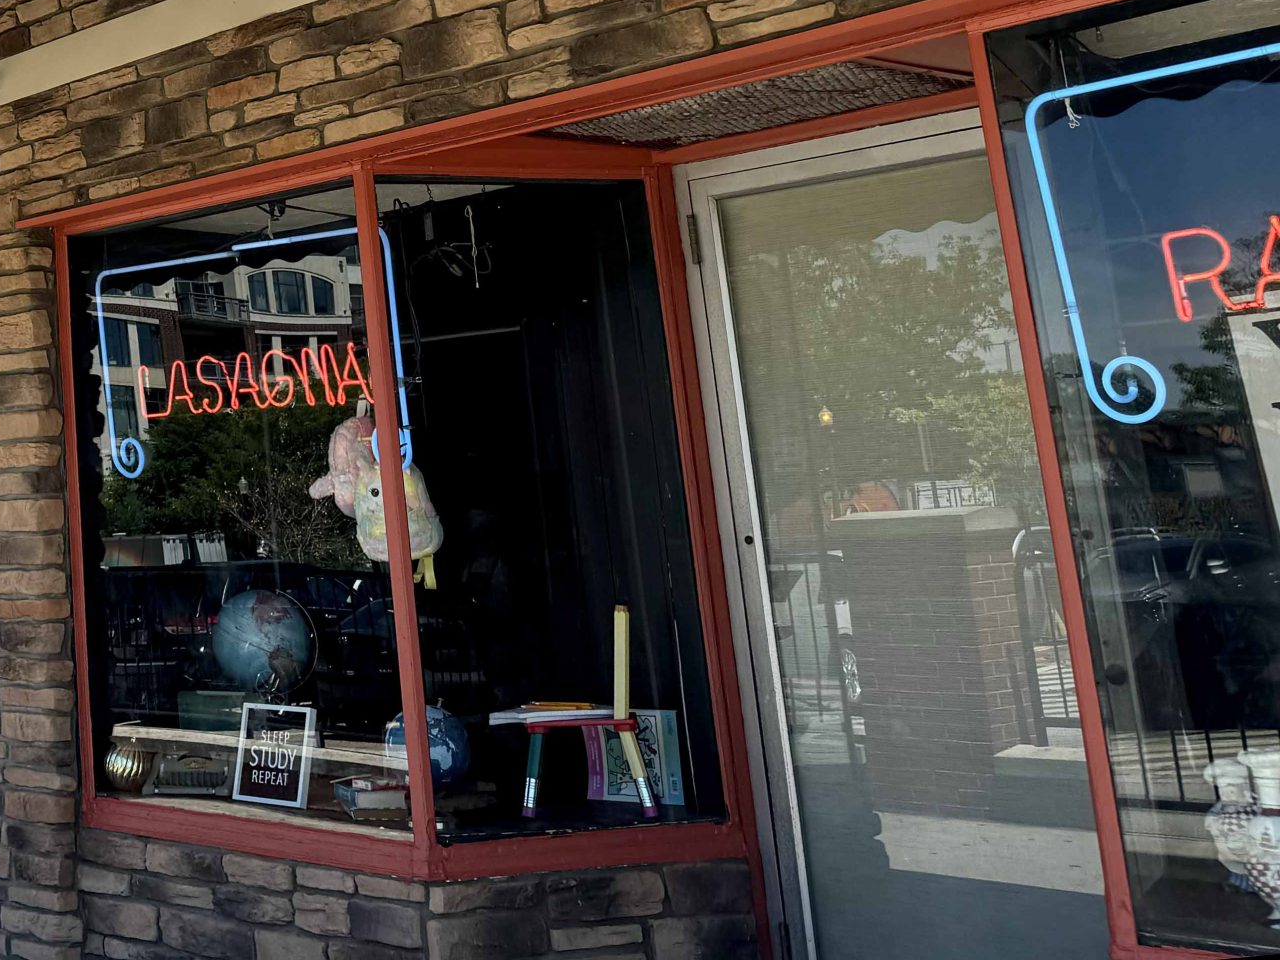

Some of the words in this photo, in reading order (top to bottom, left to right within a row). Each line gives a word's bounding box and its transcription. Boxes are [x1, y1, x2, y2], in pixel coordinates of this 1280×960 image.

[138, 342, 376, 419] LASAGNA
[261, 730, 290, 744] SLEEP
[249, 746, 297, 770] STUDY
[251, 769, 289, 786] REPEAT
